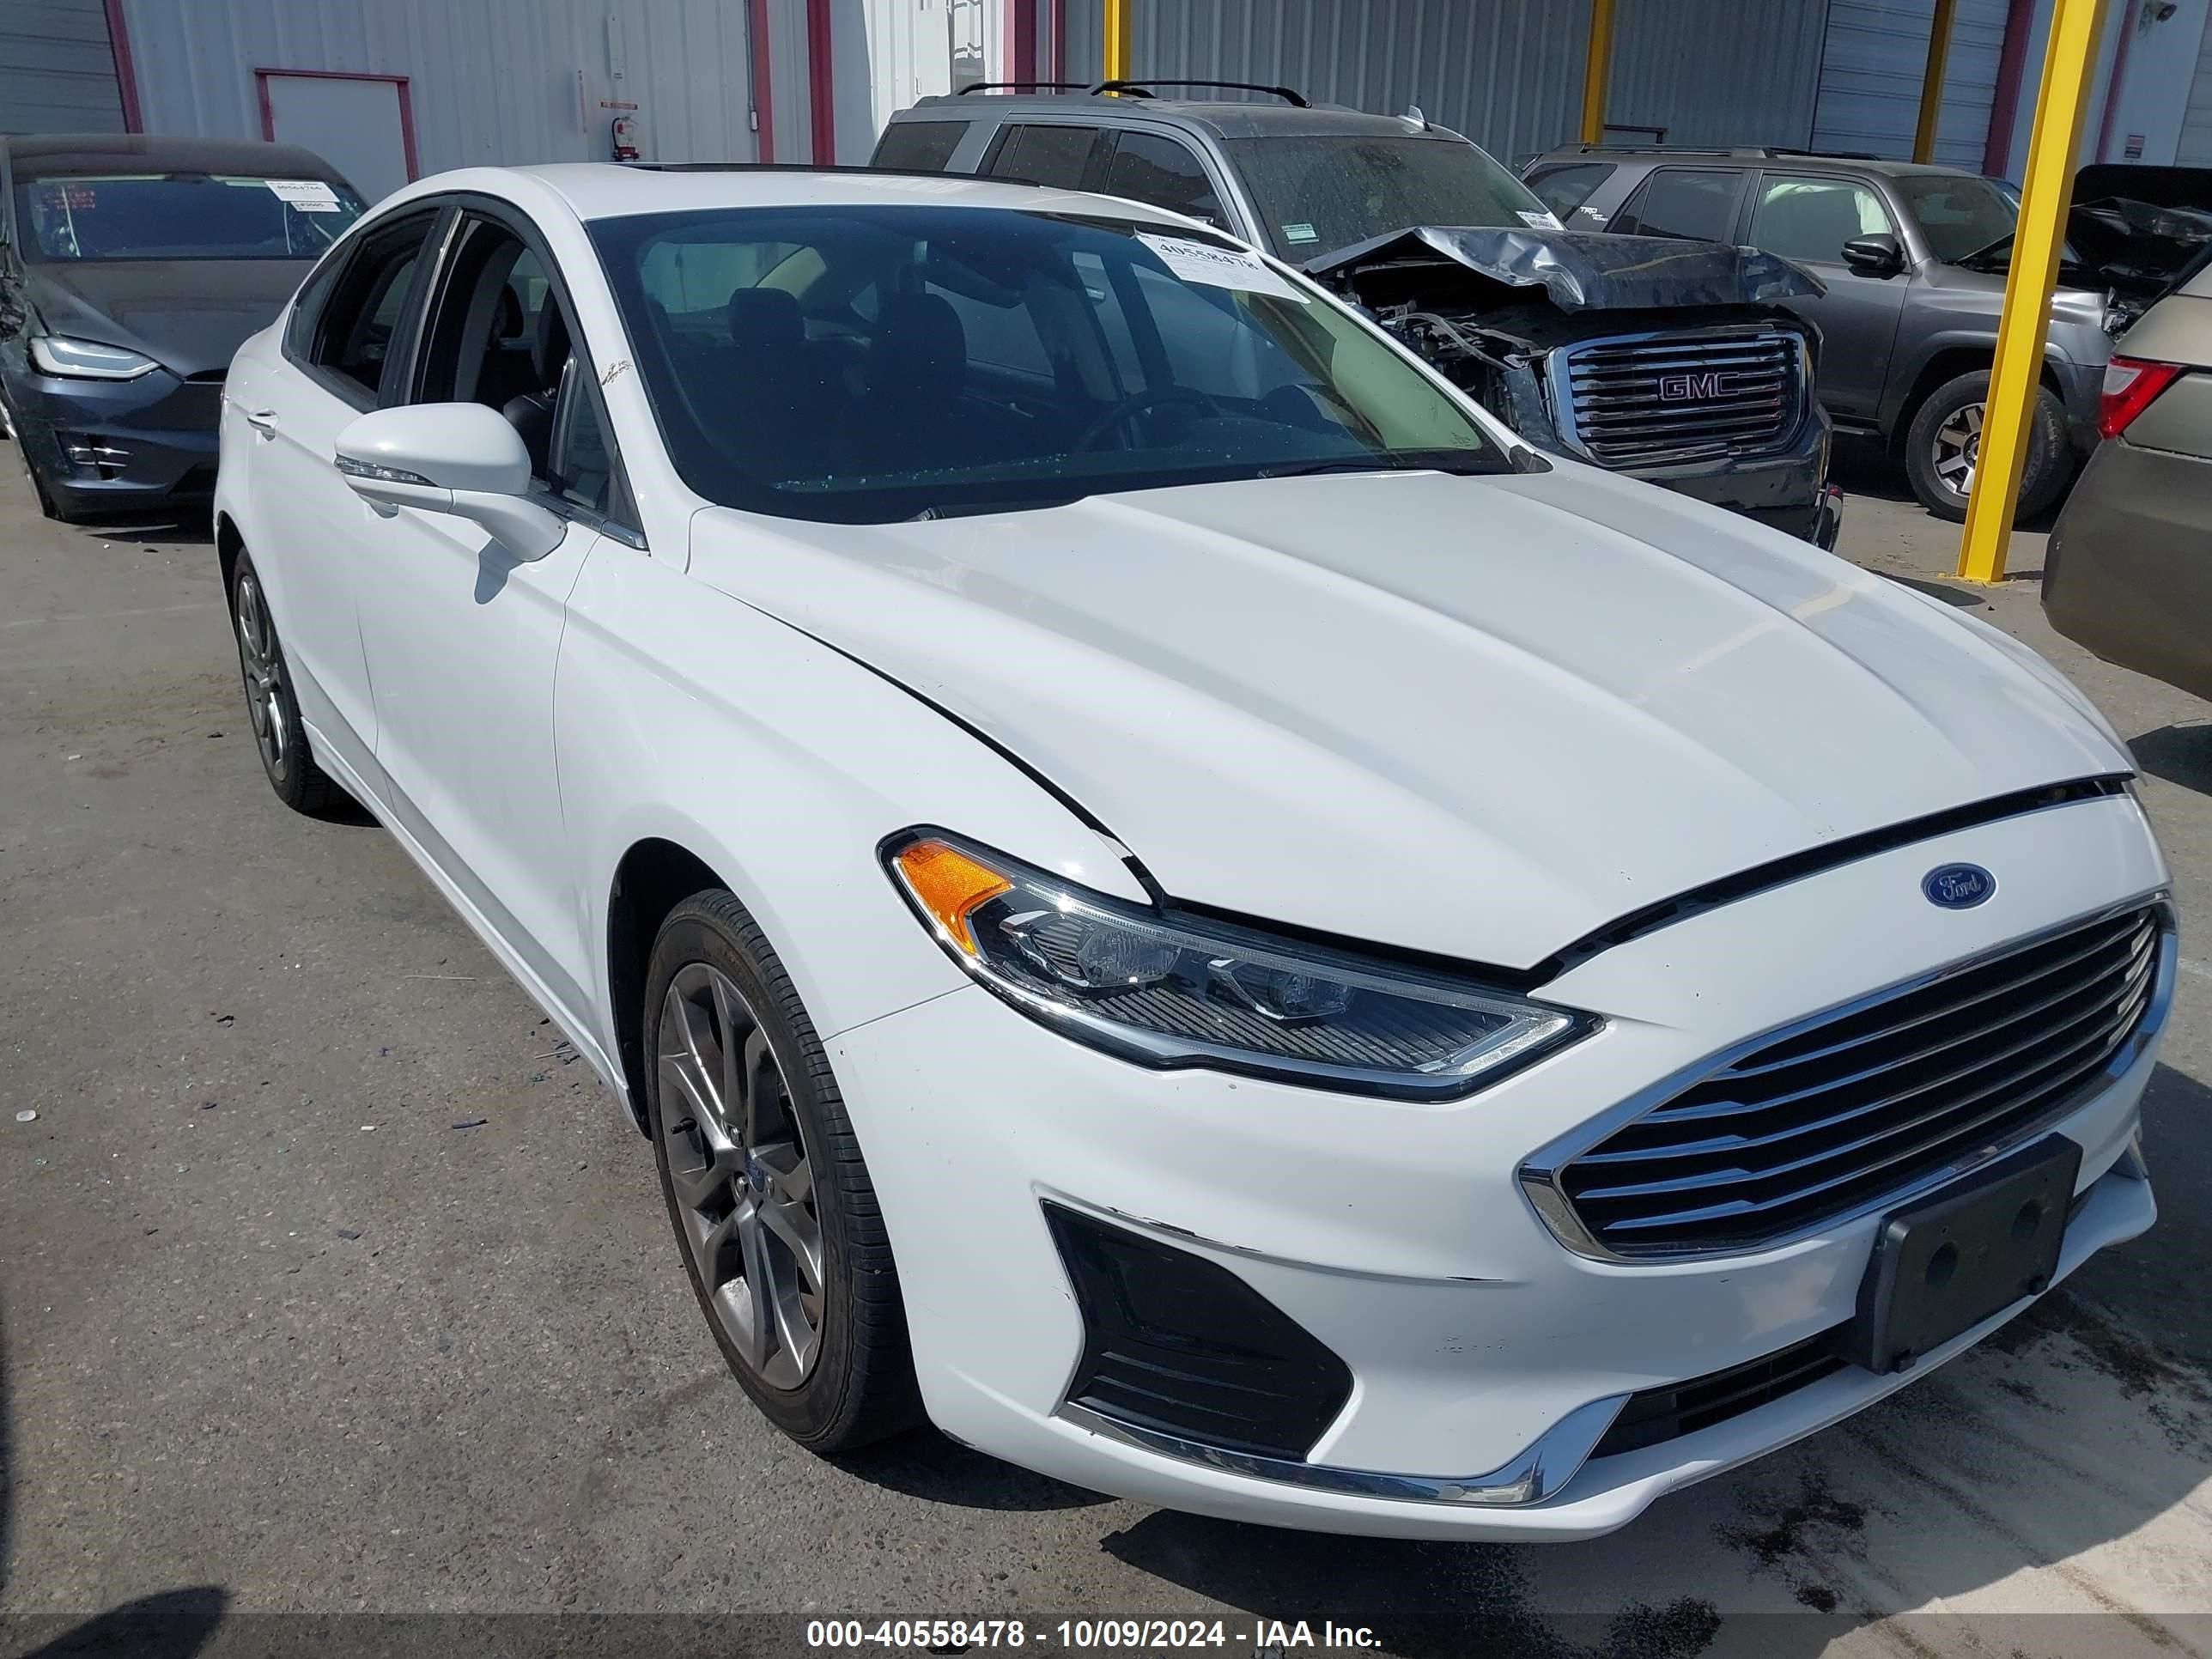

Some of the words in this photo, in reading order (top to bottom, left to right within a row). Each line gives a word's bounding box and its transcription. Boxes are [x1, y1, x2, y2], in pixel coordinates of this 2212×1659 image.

[1580, 206, 1598, 215] TRD
[1160, 244, 1259, 270] 40558478
[1660, 372, 1740, 401] GMC
[1939, 872, 1982, 901] Ford
